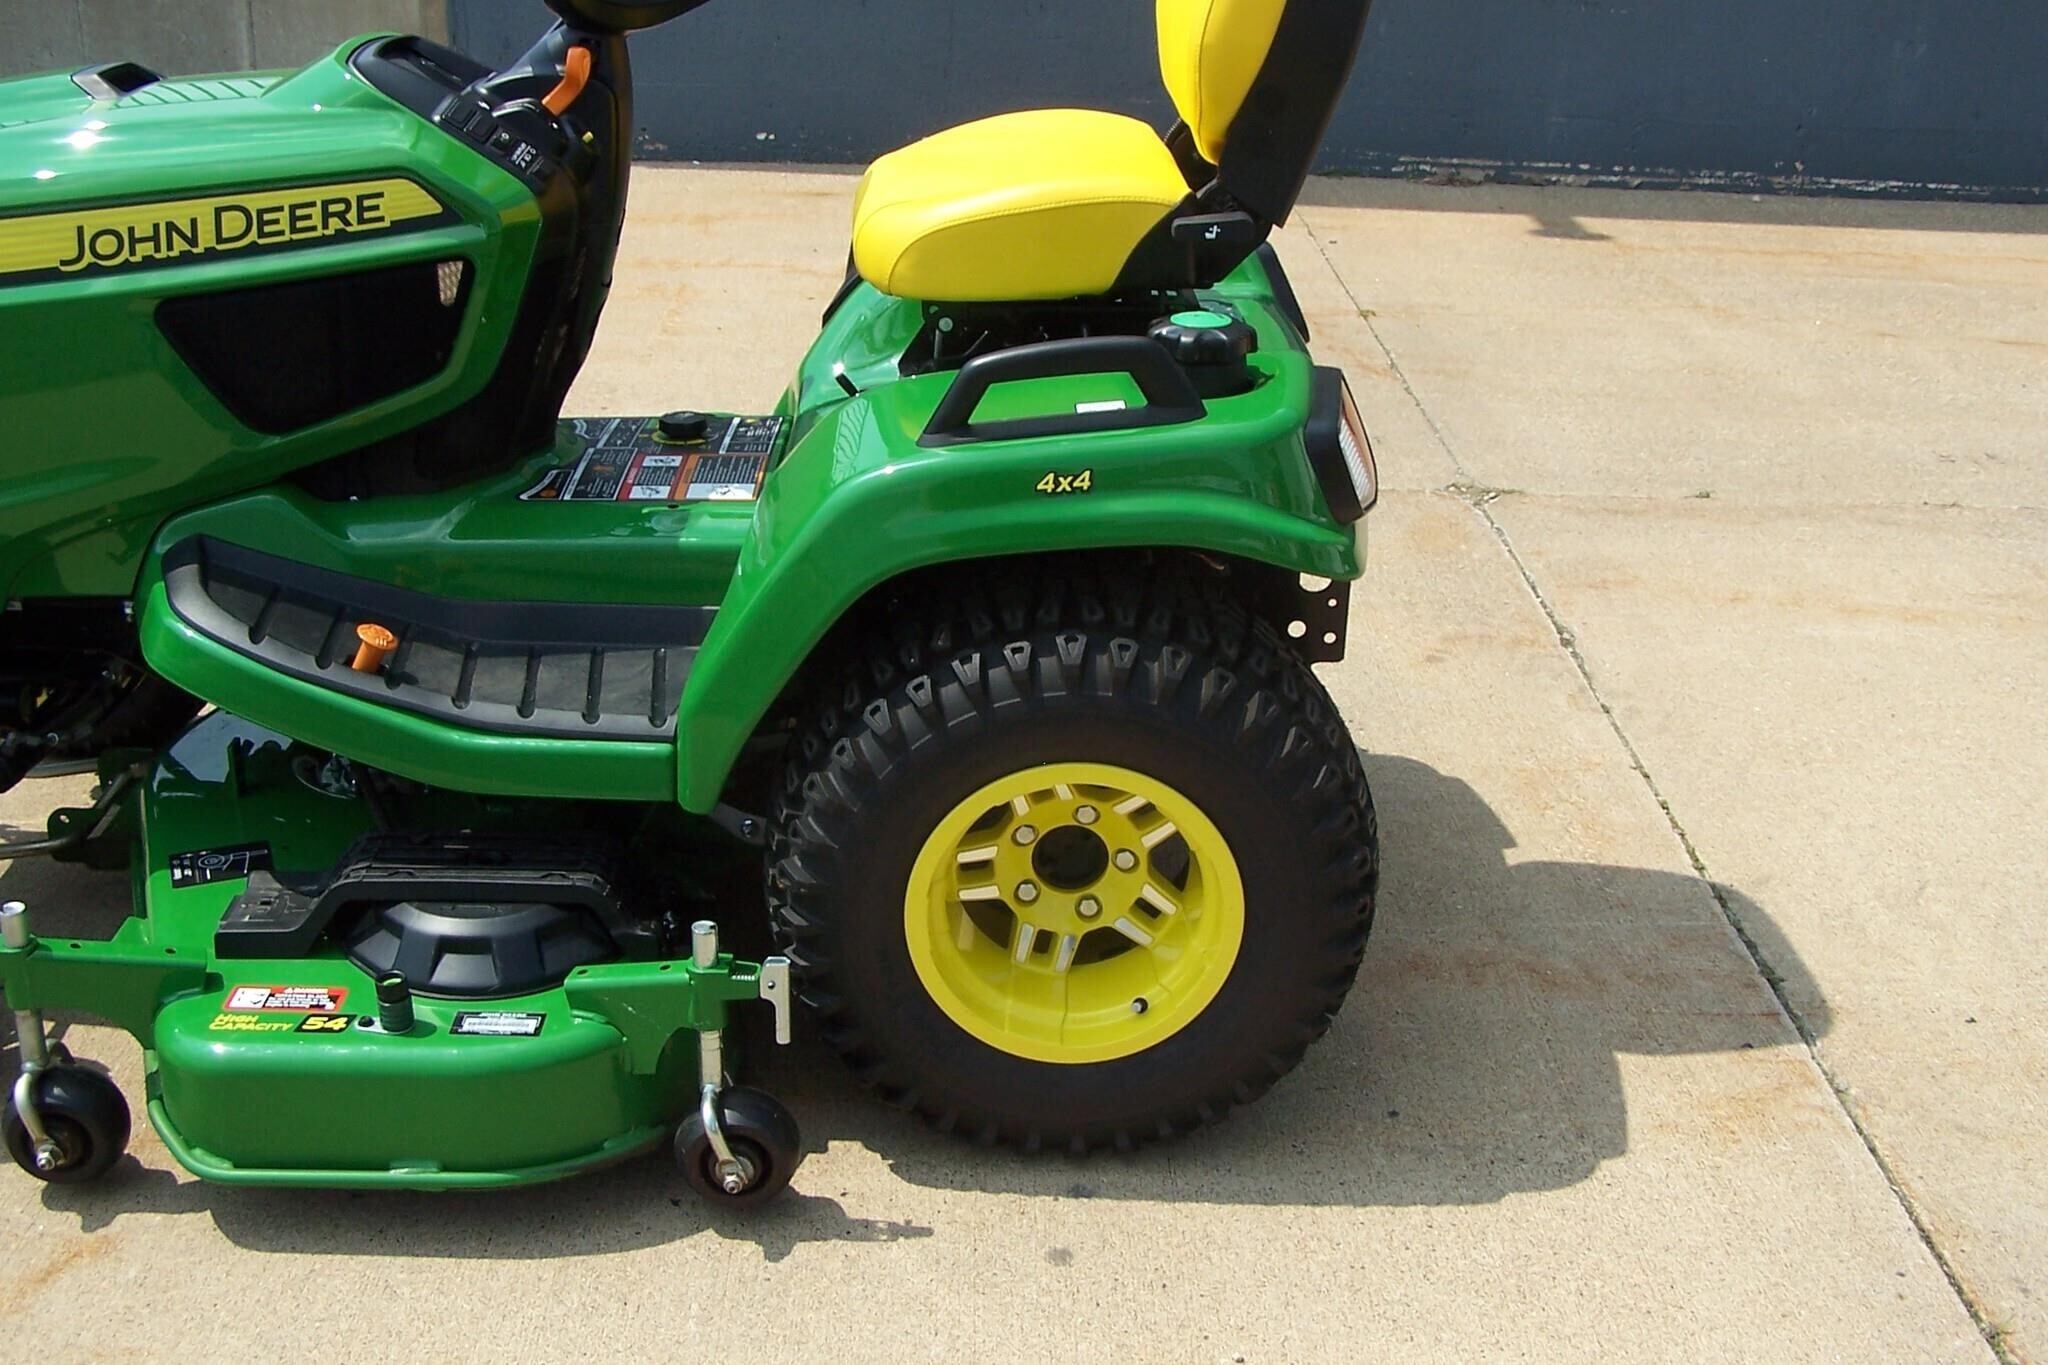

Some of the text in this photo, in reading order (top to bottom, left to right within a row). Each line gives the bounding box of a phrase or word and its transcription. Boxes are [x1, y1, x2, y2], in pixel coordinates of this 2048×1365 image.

[59, 192, 385, 267] JOHN DEERE
[1036, 470, 1091, 493] 4x4
[214, 1013, 259, 1023] HIGH
[302, 1016, 349, 1030] 54
[208, 1022, 294, 1031] CAPACITY
